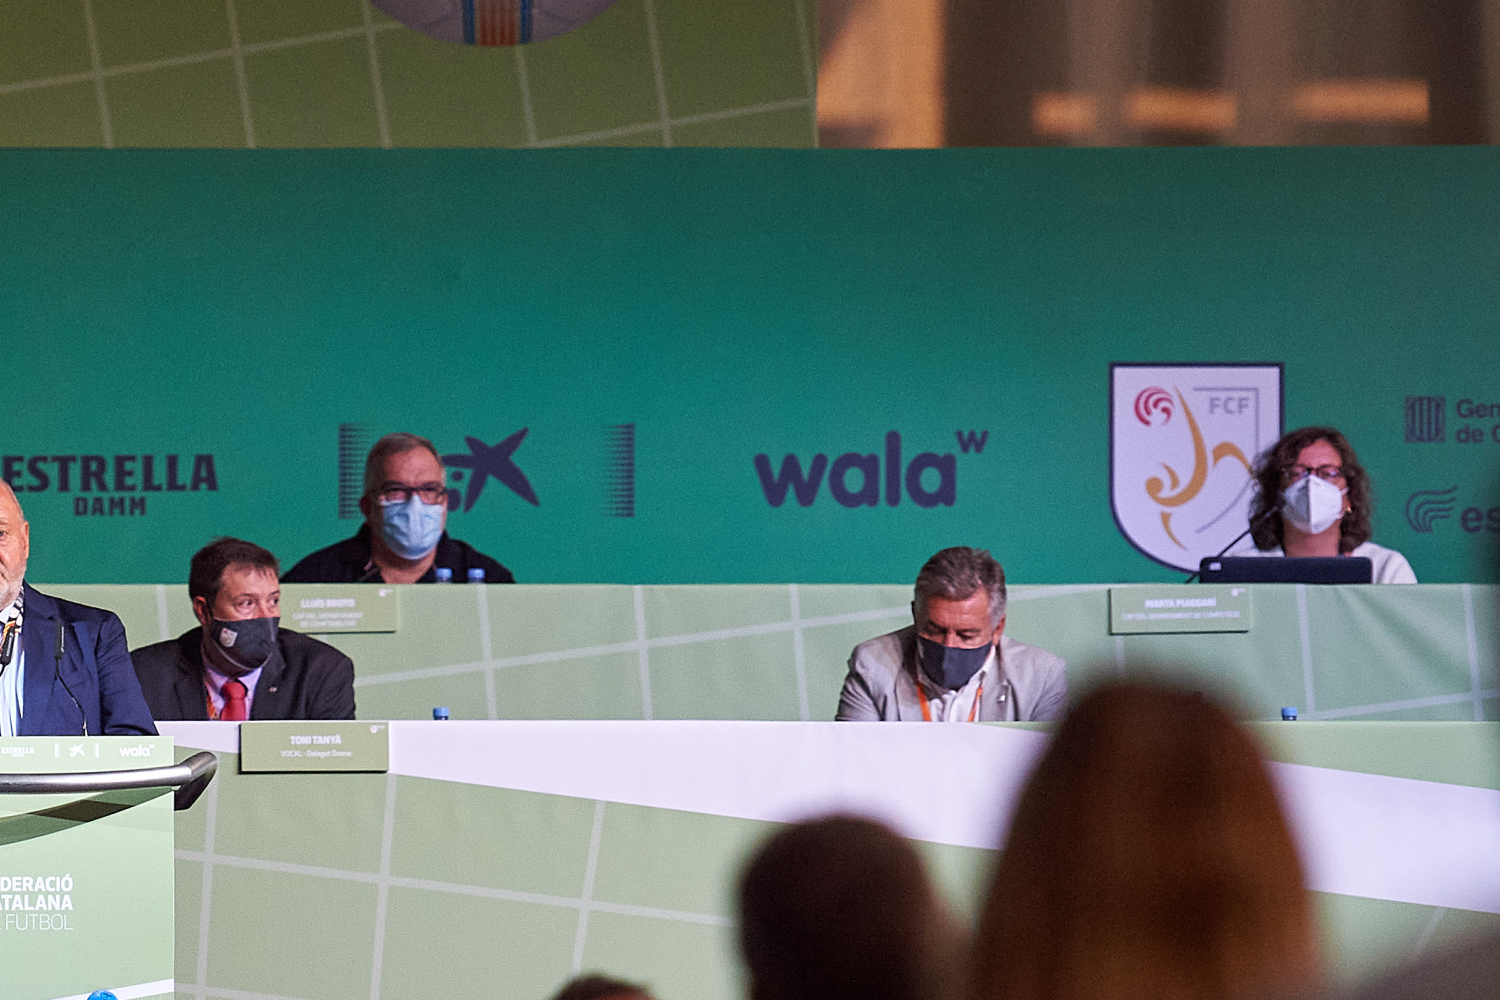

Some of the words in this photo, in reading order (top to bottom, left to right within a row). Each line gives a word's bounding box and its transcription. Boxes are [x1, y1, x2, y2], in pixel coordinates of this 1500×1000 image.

[1209, 396, 1249, 414] FCF
[1455, 424, 1484, 443] de
[2, 453, 219, 493] ESTRELLA
[753, 429, 957, 508] wala
[73, 496, 147, 517] DAMM
[5, 913, 73, 930] FUTBOL
